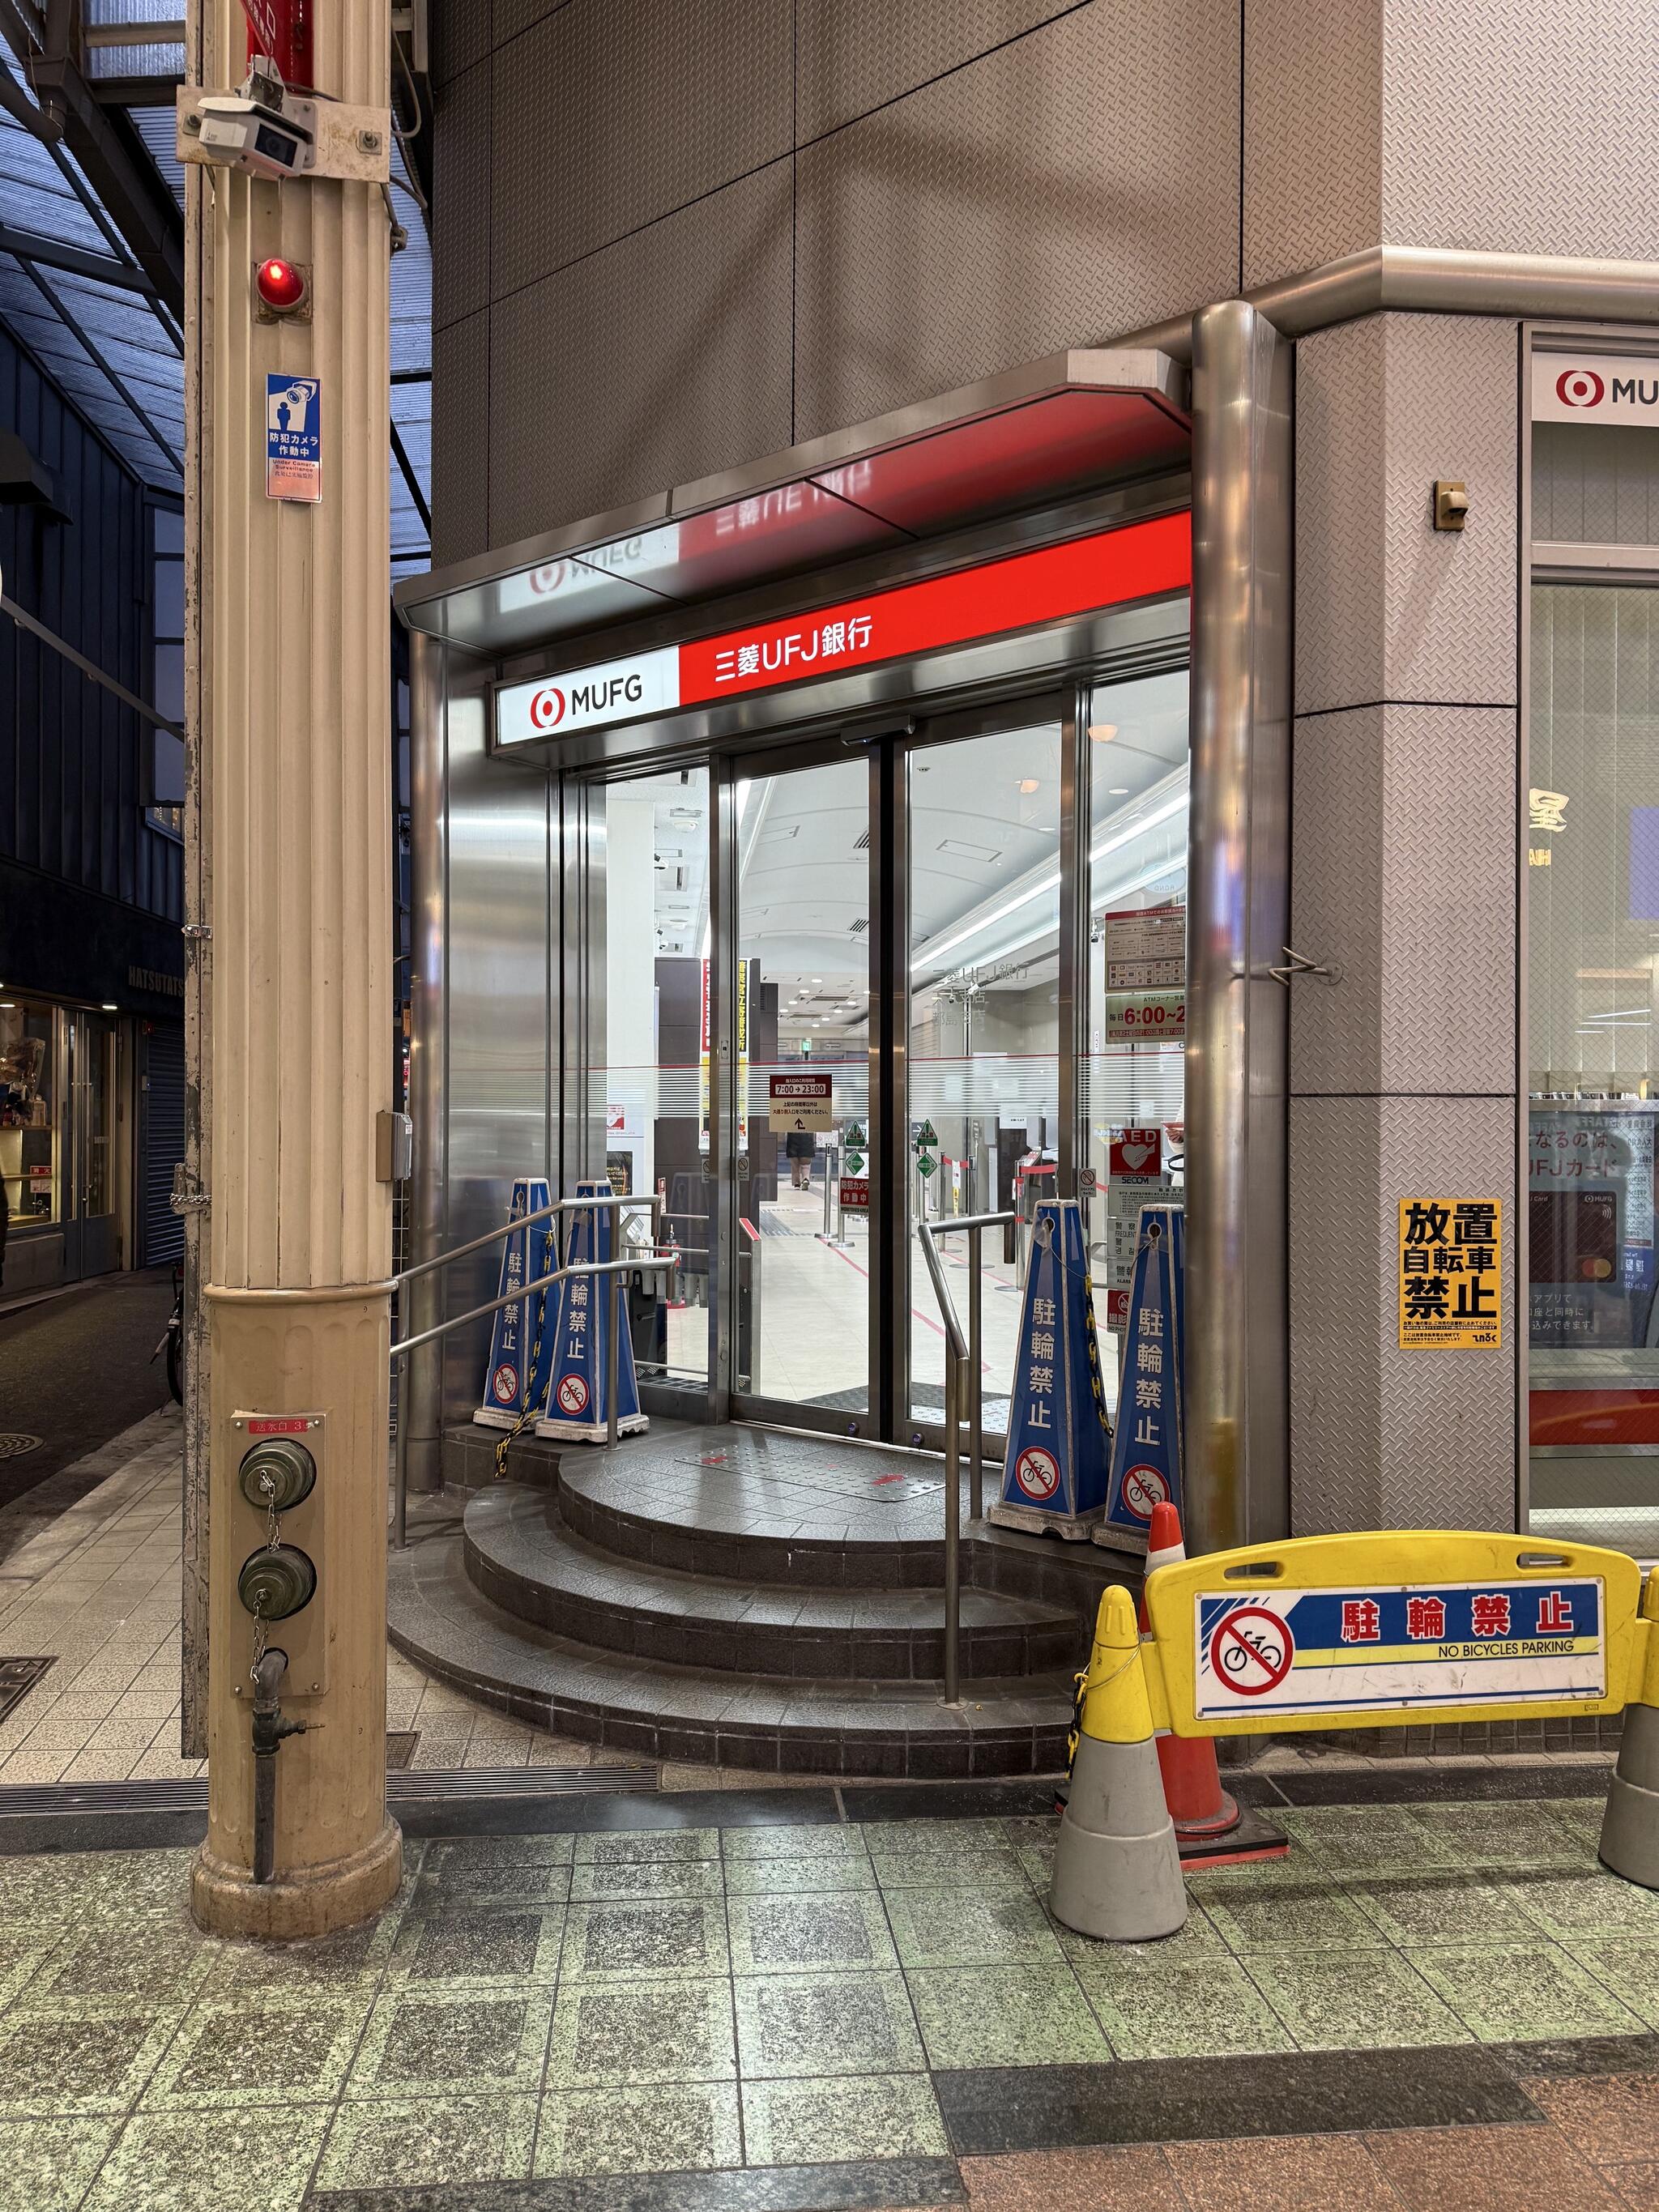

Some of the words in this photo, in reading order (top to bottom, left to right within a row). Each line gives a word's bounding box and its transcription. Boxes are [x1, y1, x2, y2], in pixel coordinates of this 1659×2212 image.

[1612, 377, 1659, 405] MU
[269, 432, 318, 446] 防犯カメラ
[279, 445, 309, 458] 作動中
[275, 464, 313, 472] Surveillance
[714, 615, 873, 683] 三菱UFJ銀行
[571, 673, 642, 716] MUFG
[1109, 1012, 1124, 1021] 毎日
[777, 1085, 794, 1093] 7:00
[802, 1085, 825, 1093] 23:00
[841, 1179, 869, 1191] 防犯カメラ
[1121, 1176, 1149, 1185] SECOM
[843, 1192, 867, 1203] 作動中
[1404, 1202, 1498, 1246] 放置
[1404, 1246, 1497, 1274] 自転車
[1404, 1276, 1498, 1319] 禁止
[1529, 1294, 1572, 1303] アプリで
[1027, 1297, 1056, 1430] 駐輪禁止
[1135, 1306, 1165, 1447] 駐輪禁止
[1341, 1591, 1575, 1643] 駐輪禁止
[1439, 1645, 1459, 1658] NO
[1463, 1642, 1519, 1657] BICYCLES
[1521, 1639, 1575, 1655] PARKING
